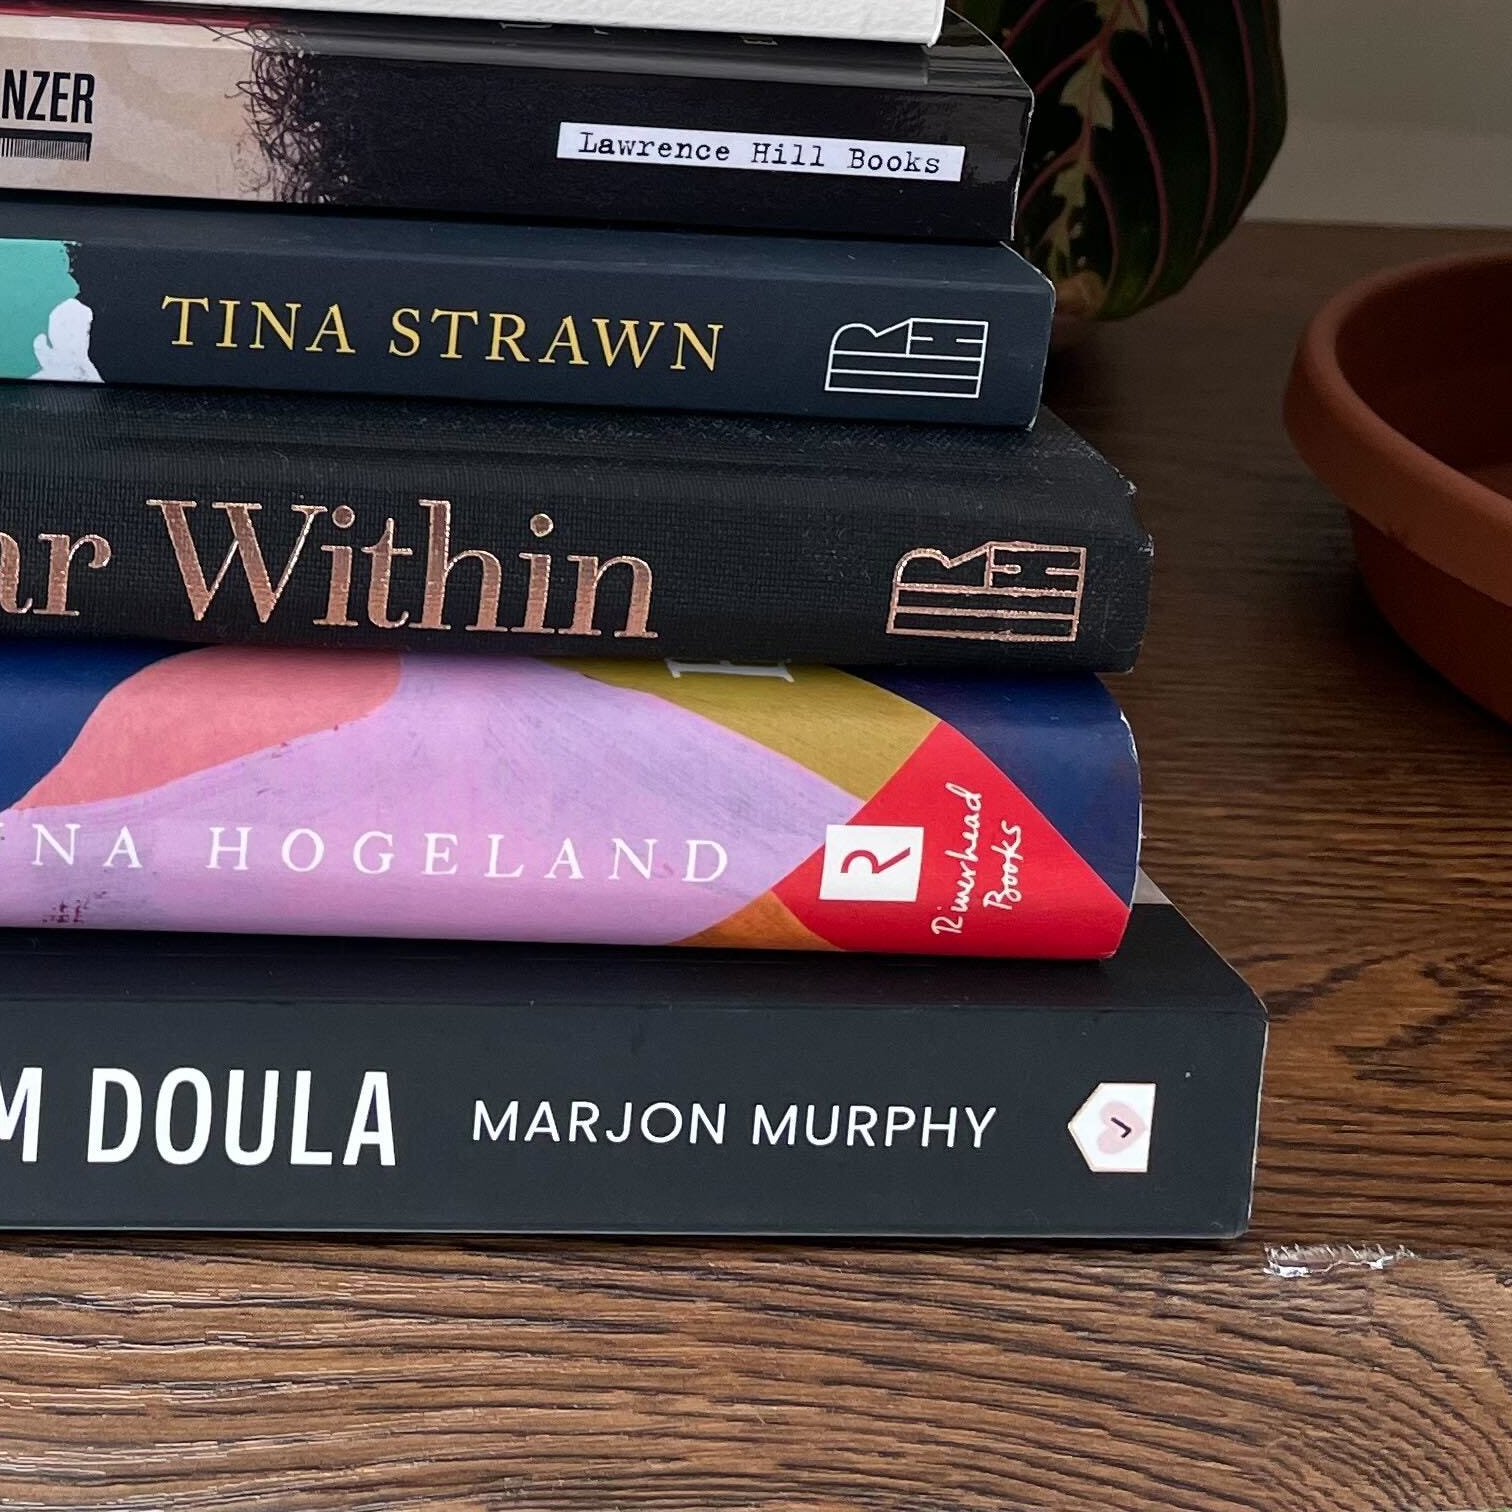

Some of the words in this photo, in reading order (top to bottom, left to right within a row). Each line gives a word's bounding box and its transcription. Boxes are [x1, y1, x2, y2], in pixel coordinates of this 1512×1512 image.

[579, 132, 729, 160] Lawrence
[751, 143, 824, 166] Hill
[849, 148, 939, 173] Books
[162, 296, 355, 353] TINA
[389, 308, 723, 371] STRAWN
[146, 499, 658, 638] Within
[206, 827, 730, 883] HOGELAND
[930, 783, 982, 935] Riverhead
[983, 821, 1023, 910] Books
[87, 1068, 395, 1166] DOULA
[473, 1100, 725, 1144] MARJON
[753, 1105, 996, 1148] MURPHY
